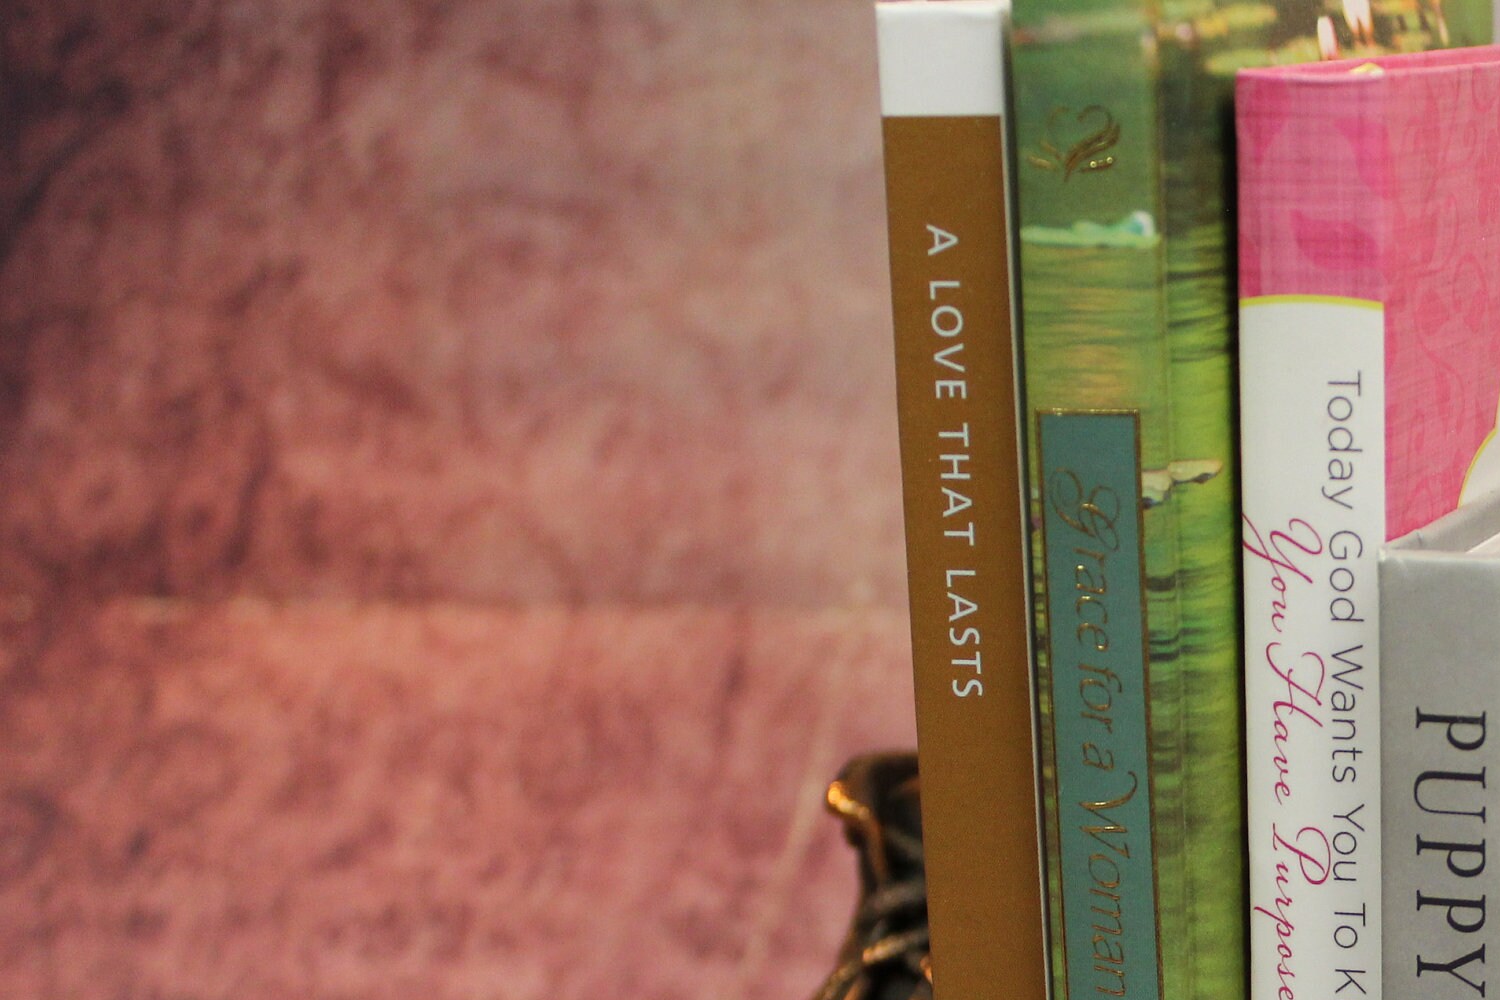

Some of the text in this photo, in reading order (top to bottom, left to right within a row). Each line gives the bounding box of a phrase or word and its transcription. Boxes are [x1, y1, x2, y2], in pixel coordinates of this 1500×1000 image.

[926, 223, 983, 697] A LOVE THAT LASTS
[1321, 370, 1363, 510] Today
[1049, 466, 1121, 651] Grace
[1241, 512, 1323, 633] You
[1329, 529, 1364, 622] God
[1078, 663, 1123, 734] for
[1082, 742, 1114, 772] a
[1266, 641, 1325, 807] Have
[1331, 644, 1365, 783] Wants
[1333, 803, 1366, 882] You
[1334, 903, 1367, 949] To
